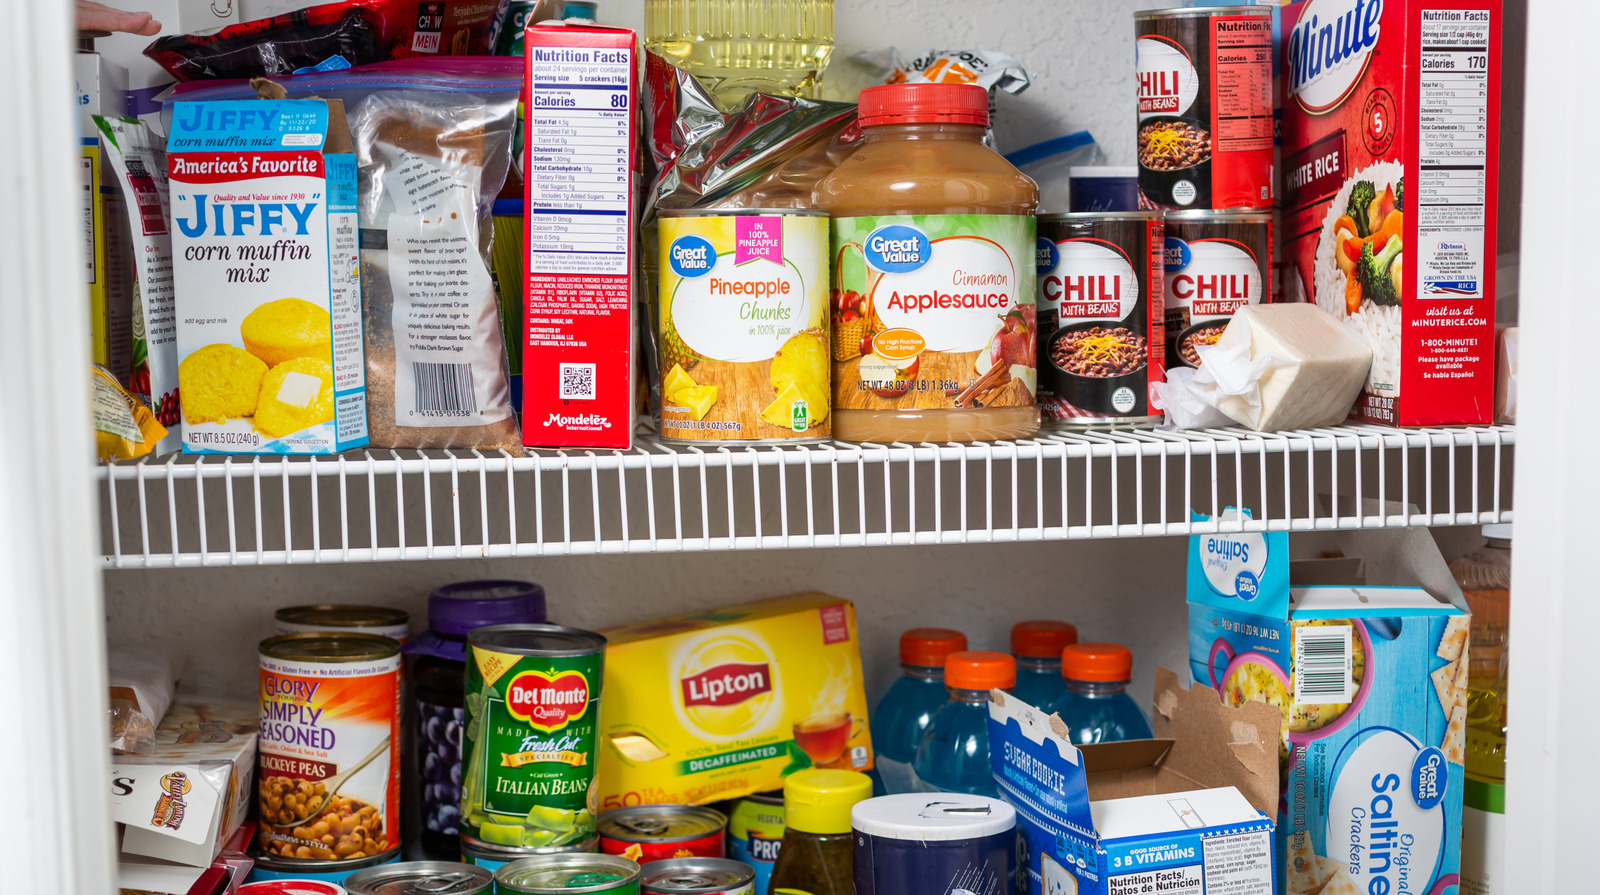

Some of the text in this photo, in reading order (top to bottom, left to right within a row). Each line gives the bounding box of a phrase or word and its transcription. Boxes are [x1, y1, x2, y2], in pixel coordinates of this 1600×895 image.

[418, 15, 443, 29] CHOW
[1423, 11, 1488, 21] Nutrition Facts
[1218, 22, 1262, 32] Nutrition
[415, 34, 439, 49] MEIN
[1289, 0, 1382, 95] Minute
[535, 50, 628, 63] Nutrition Facts
[1422, 56, 1486, 69] Calories 170
[534, 74, 556, 82] Serving
[534, 94, 628, 108] Calories 80
[1152, 97, 1177, 110] BEANS
[1374, 112, 1383, 133] 5
[174, 138, 204, 147] corn
[207, 135, 248, 148] muffin
[250, 136, 276, 147] mix
[1372, 132, 1392, 151] MINUTES
[173, 156, 317, 175] America's Favorite
[1286, 151, 1340, 192] WHITE RICE
[213, 194, 237, 203] Quality
[252, 193, 270, 201] Value
[290, 193, 305, 201] 1930
[748, 231, 769, 239] 100%
[185, 240, 312, 262] corn muffin
[673, 245, 708, 260] Great
[747, 248, 770, 256] JUICE
[871, 236, 920, 254] Great
[680, 258, 707, 269] Value
[882, 250, 920, 264] Value
[226, 263, 270, 284] mix
[953, 269, 1008, 286] Cinnamon
[710, 278, 791, 299] Pineapple
[1042, 275, 1121, 301] CHILI
[1171, 274, 1249, 300] CHILI
[887, 290, 1009, 314] Applesauce
[1062, 302, 1120, 317] WITH BEANS
[1194, 301, 1247, 314] WITH BEAN
[740, 301, 791, 321] Chunks
[1426, 306, 1475, 316] visit us at
[1411, 318, 1487, 327] MINUTERICE.COM
[749, 325, 791, 340] in 100% juice
[1421, 338, 1478, 347] 1-800-MINUTE1
[1455, 356, 1480, 364] package
[1451, 371, 1474, 380] Español
[858, 379, 959, 393] NET WT 48 OZ LB) 1.36kg
[543, 414, 612, 428] Mondelēz
[189, 433, 252, 446] NET WT 8.5 OZ (240
[1208, 538, 1250, 563] Saltine
[1208, 558, 1228, 572] Original
[1239, 582, 1257, 596] Great
[1260, 628, 1280, 641] NET WT
[282, 666, 298, 674] Gluten
[329, 668, 352, 676] Artificial
[265, 676, 321, 704] GLORY
[689, 672, 764, 702] Lipton
[512, 686, 586, 705] Del Monte
[263, 701, 325, 728] SIMPLY
[534, 706, 566, 719] Quality
[497, 726, 591, 737] MADE WITH
[519, 735, 583, 753] Fresh Cut
[519, 754, 574, 762] SPECIALTIES
[690, 746, 777, 772] DECAFFEINATED
[299, 762, 326, 778] PEAS
[1004, 741, 1032, 776] SUGAR
[1032, 758, 1066, 796] COOKIE
[1295, 746, 1306, 803] NET WT 16 OZ
[1418, 765, 1428, 800] Value
[1427, 754, 1441, 799] Great
[495, 777, 588, 796] ITALIAN BEANS
[604, 792, 642, 808] 50
[1350, 807, 1366, 875] Crackers
[1368, 773, 1401, 895] Saltine
[1114, 847, 1195, 868] 3 B VITAMINS
[1393, 833, 1415, 895] Original
[1110, 870, 1186, 888] Nutrition Facts/
[1142, 877, 1200, 893] de Nutrición
